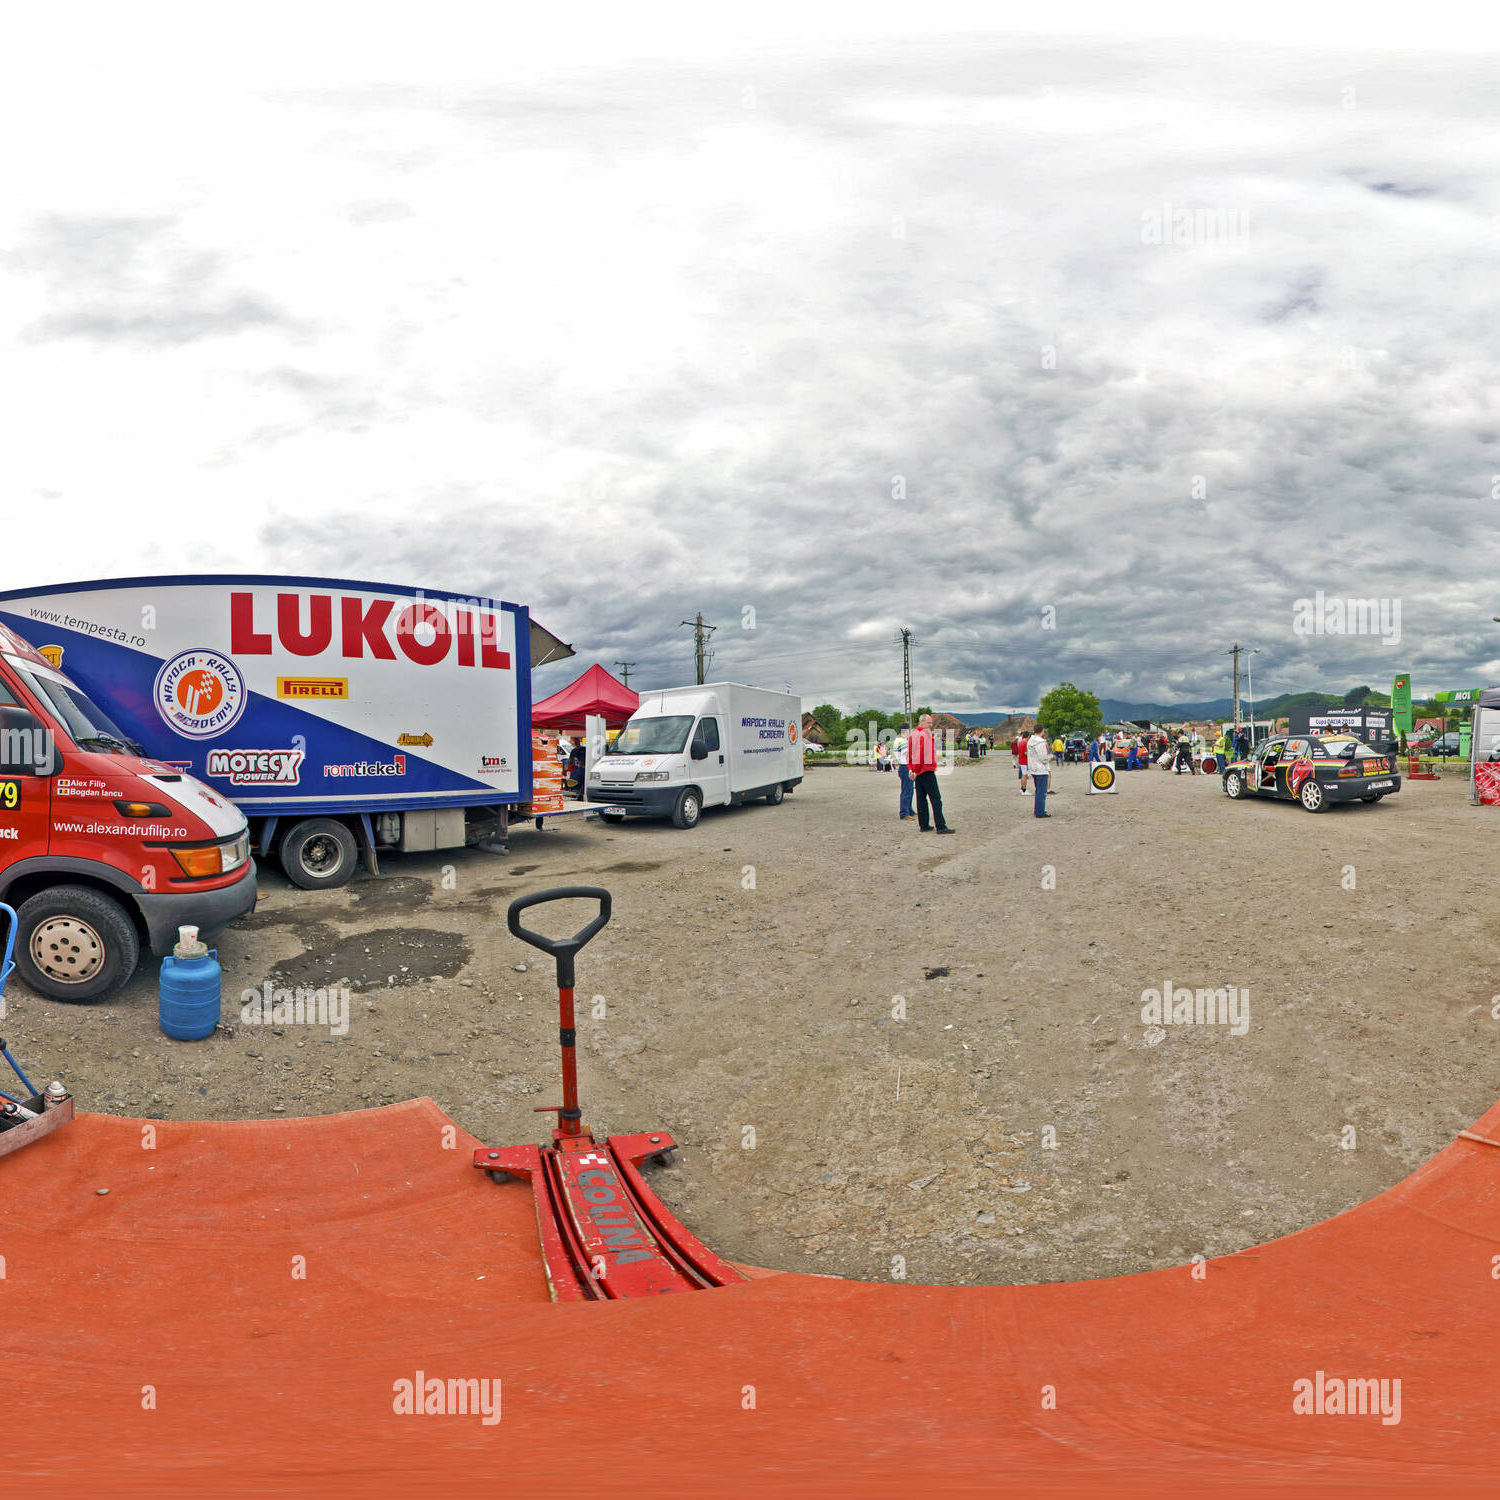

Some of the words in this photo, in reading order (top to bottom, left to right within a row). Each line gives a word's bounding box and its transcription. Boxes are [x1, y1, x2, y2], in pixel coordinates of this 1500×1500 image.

[30, 607, 146, 647] www.tempesta.ro
[230, 592, 510, 670] LUKOIL
[164, 656, 196, 703] NAPOCA
[206, 658, 238, 692] RALLY
[284, 680, 343, 696] PIRELLI
[1455, 692, 1471, 700] MOL
[174, 701, 233, 729] ACADEMY
[742, 718, 767, 727] NAPOCA
[768, 719, 785, 727] RALLY
[759, 730, 784, 739] ACADEMY
[324, 761, 404, 777] romticket
[70, 779, 87, 787] Alex
[90, 780, 106, 788] Filip
[70, 788, 100, 797] Bogdan
[54, 822, 188, 839] www.alexandrufilip.ro
[578, 1168, 654, 1266] COLINA
